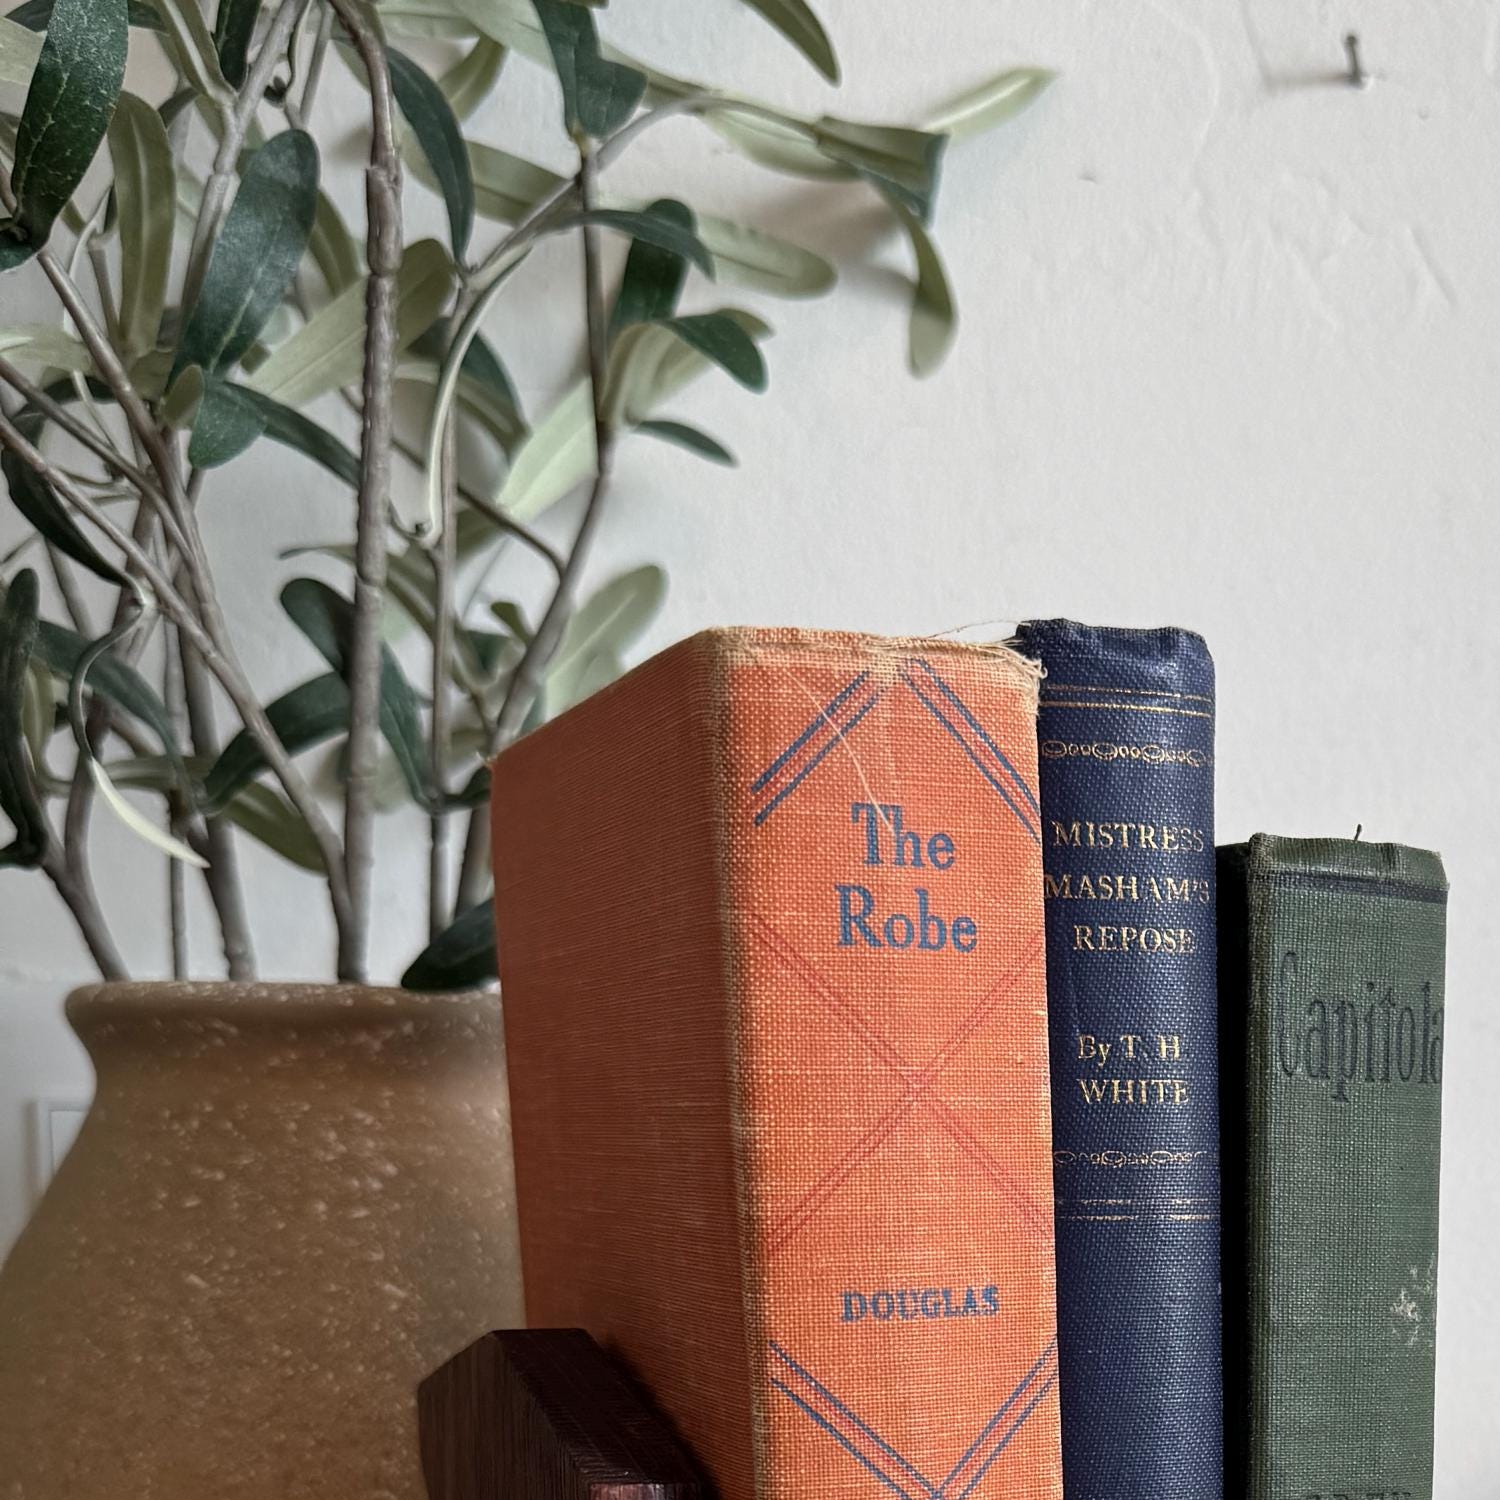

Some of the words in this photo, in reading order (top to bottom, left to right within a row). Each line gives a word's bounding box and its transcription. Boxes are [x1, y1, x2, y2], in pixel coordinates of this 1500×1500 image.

[851, 801, 955, 870] The
[1051, 820, 1204, 852] MISTRESS
[1044, 873, 1210, 904] MASHAM'S
[834, 884, 978, 953] Robe
[1073, 924, 1197, 953] REPOSE
[1077, 1034, 1112, 1067] By
[1077, 1078, 1189, 1104] WHITE
[840, 1284, 1000, 1323] DOUGLAS
